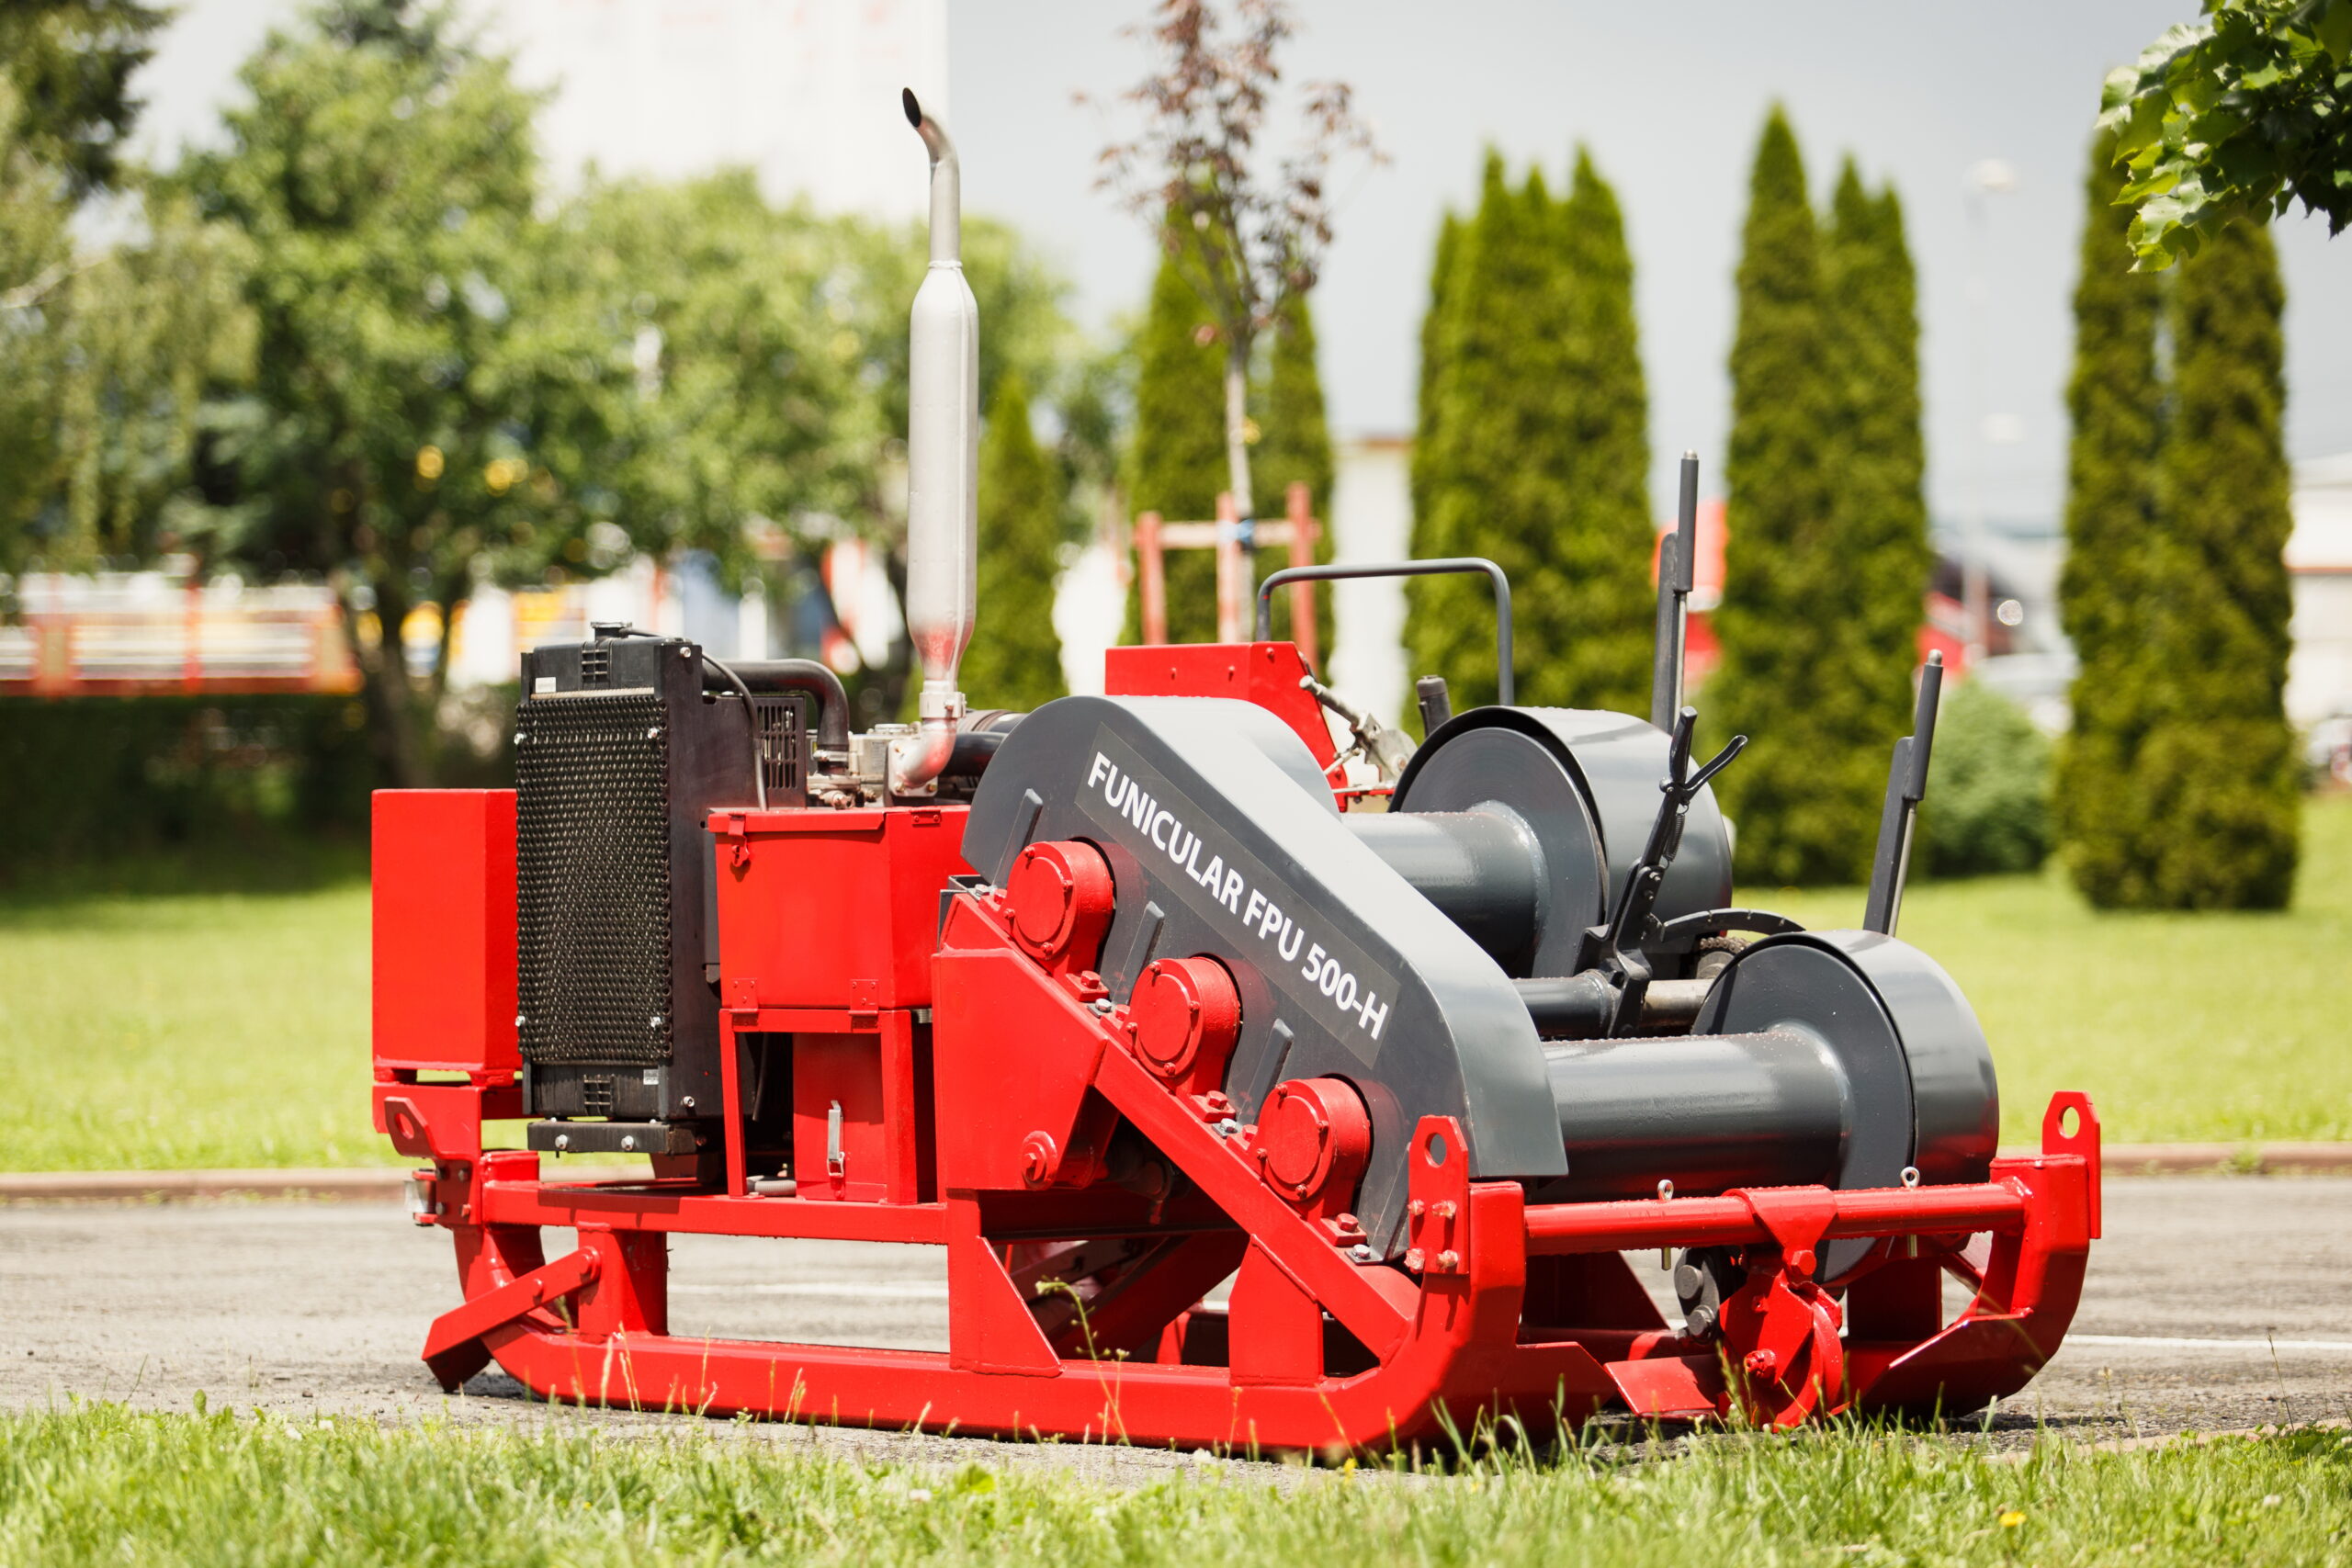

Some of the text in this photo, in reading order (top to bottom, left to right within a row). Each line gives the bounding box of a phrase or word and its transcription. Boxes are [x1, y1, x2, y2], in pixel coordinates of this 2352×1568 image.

[1087, 750, 1389, 1041] FUNICULAR FPU 500-H
